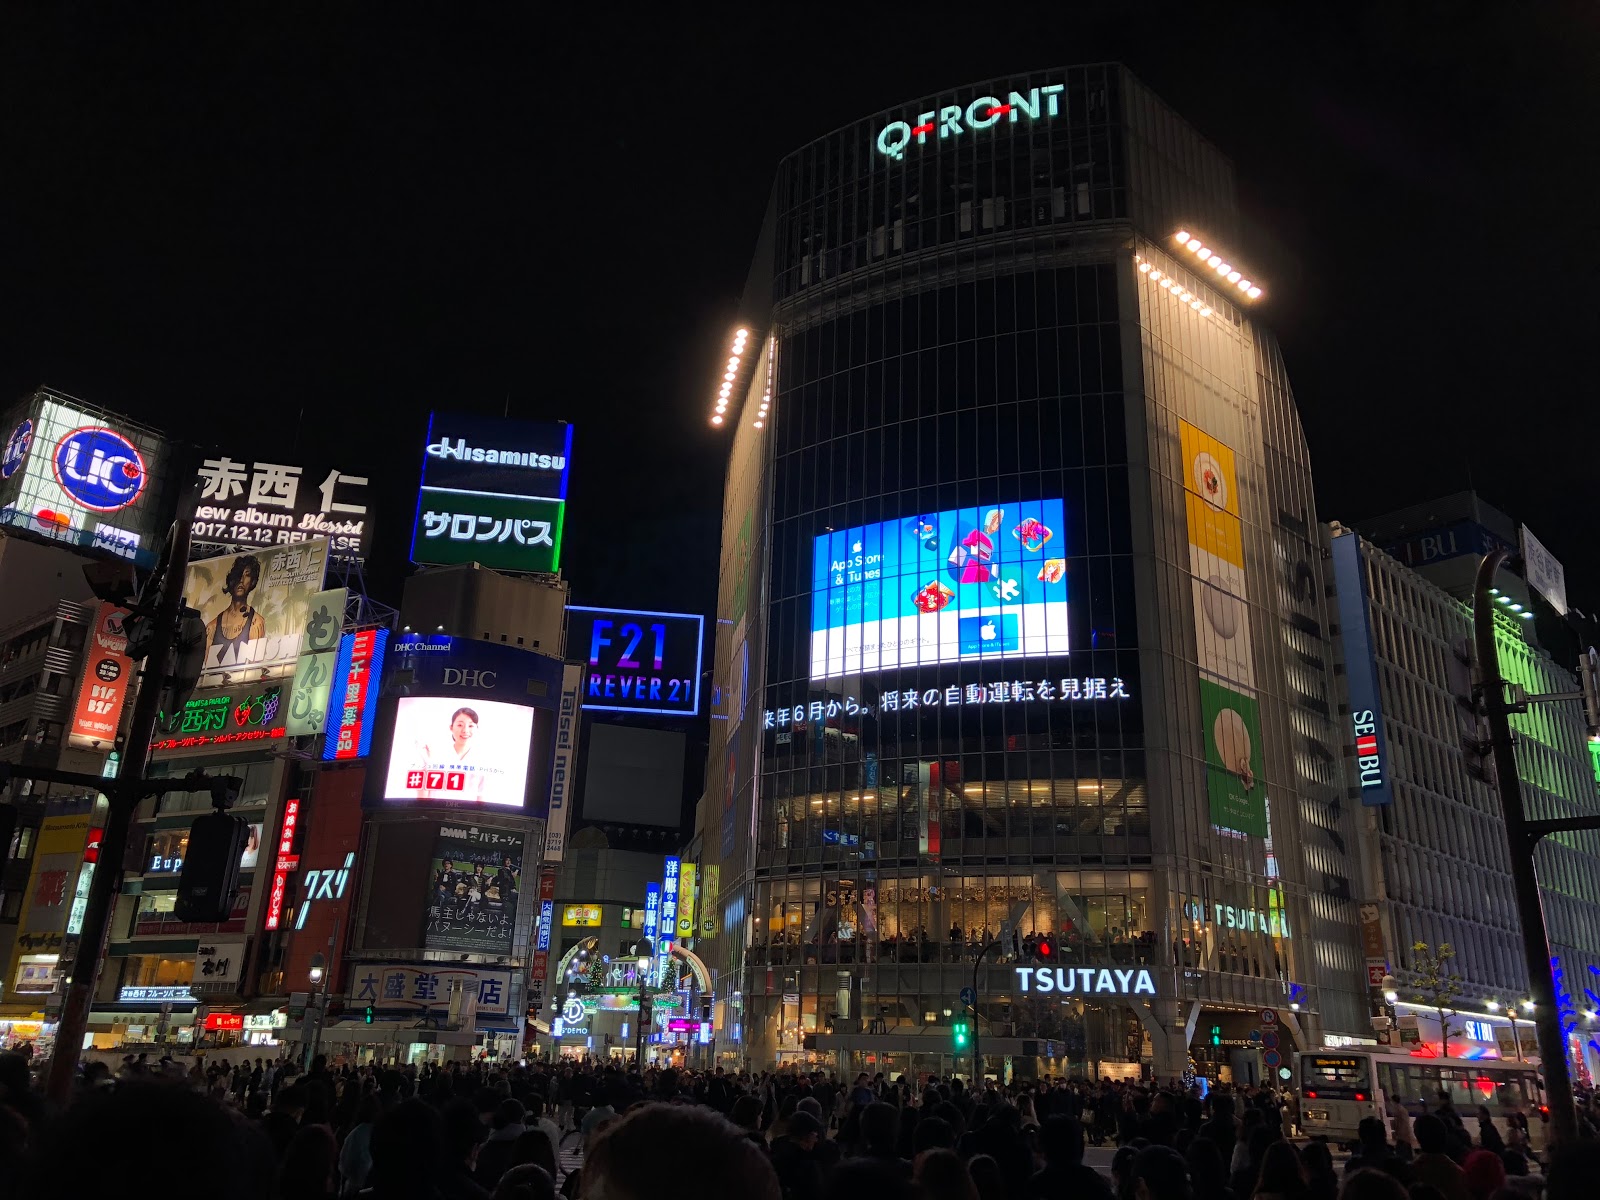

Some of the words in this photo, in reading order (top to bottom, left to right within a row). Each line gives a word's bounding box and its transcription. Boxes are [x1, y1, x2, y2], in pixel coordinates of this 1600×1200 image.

[426, 437, 566, 470] Hisamitsu
[233, 508, 293, 528] album
[423, 511, 553, 546] サロンパス
[831, 560, 853, 572] App
[835, 573, 843, 585] &
[846, 569, 881, 583] Tunes
[394, 643, 414, 652] DHC
[415, 642, 451, 652] Channel
[589, 619, 666, 670] F21
[291, 605, 340, 730] もんじゃ
[442, 668, 497, 689] DHC
[91, 684, 116, 699] B1F
[589, 673, 662, 701] REVER
[668, 678, 691, 702] 21
[881, 676, 1131, 712] 将来の自動運転を見据え
[87, 700, 113, 714] B2F
[182, 706, 229, 733] 西村
[558, 685, 577, 749] Taisei
[763, 697, 869, 730] 来年6月から。
[1353, 709, 1382, 789] SEIBU
[550, 755, 567, 809] neon
[440, 826, 467, 840] DMM
[479, 832, 522, 846] バヌーシー
[304, 856, 353, 899] クスリ
[662, 860, 678, 934] 洋服の青山
[680, 920, 690, 930] 4F
[1215, 903, 1292, 939] TSUTAYA
[357, 972, 503, 1005] 大盛堂店
[1016, 967, 1156, 994] TSUTAYA
[1370, 968, 1384, 983] 本
[1465, 1021, 1494, 1042] SEIBU
